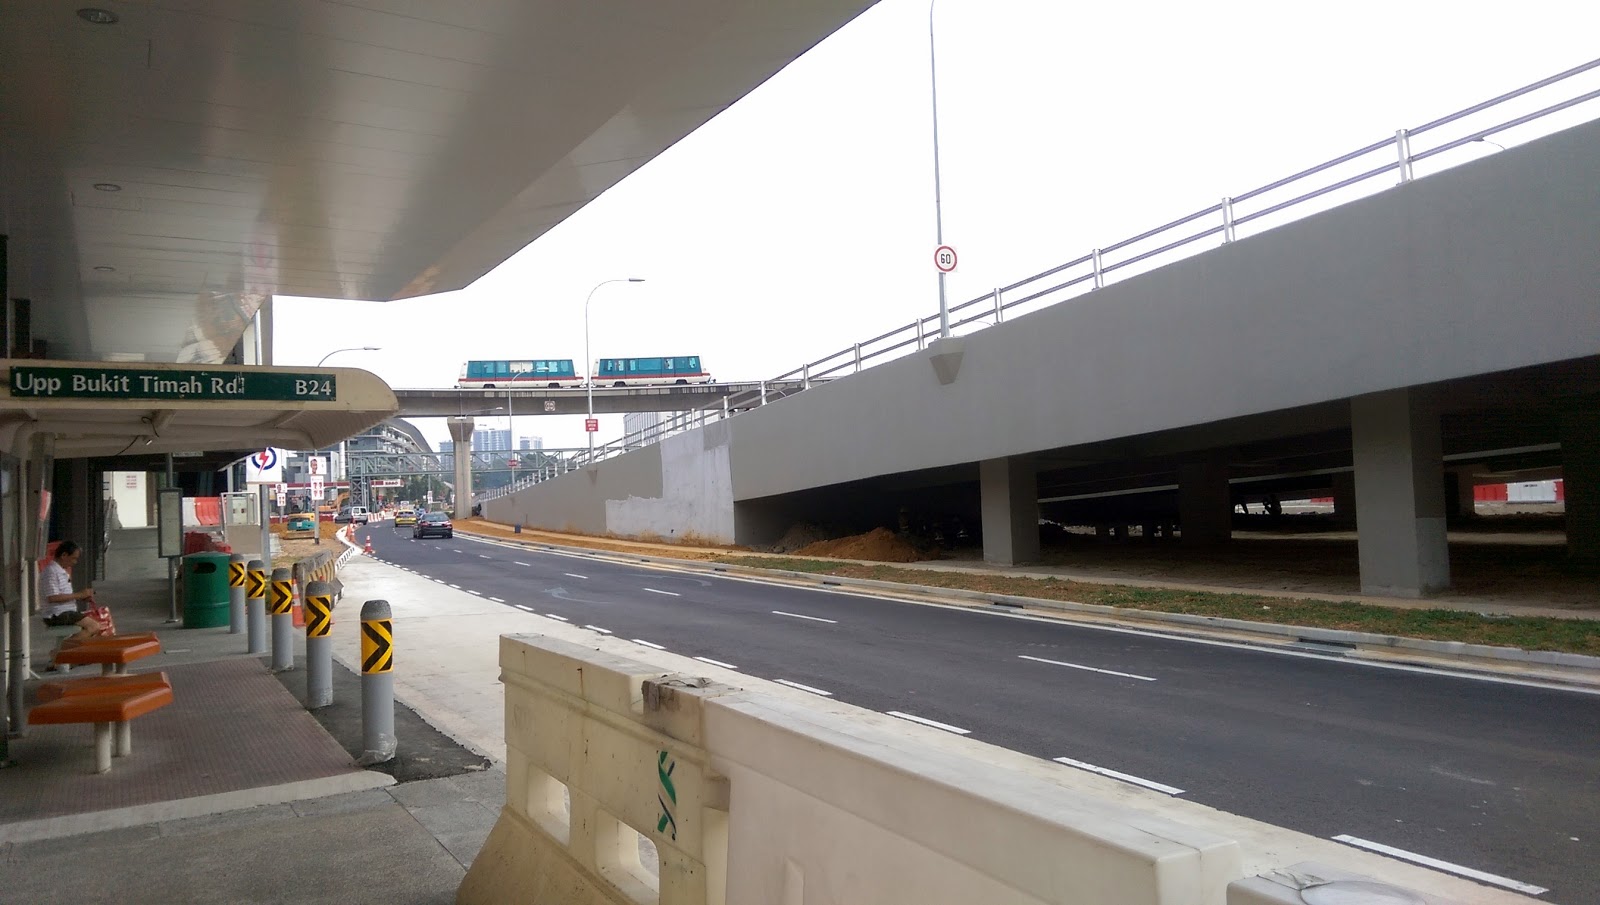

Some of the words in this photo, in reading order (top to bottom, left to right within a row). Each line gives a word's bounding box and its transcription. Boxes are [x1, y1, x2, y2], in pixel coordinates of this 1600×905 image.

[940, 253, 951, 264] 60
[15, 372, 61, 395] Upp
[72, 373, 130, 392] Bukit
[139, 375, 202, 394] Timah
[295, 379, 332, 396] B24
